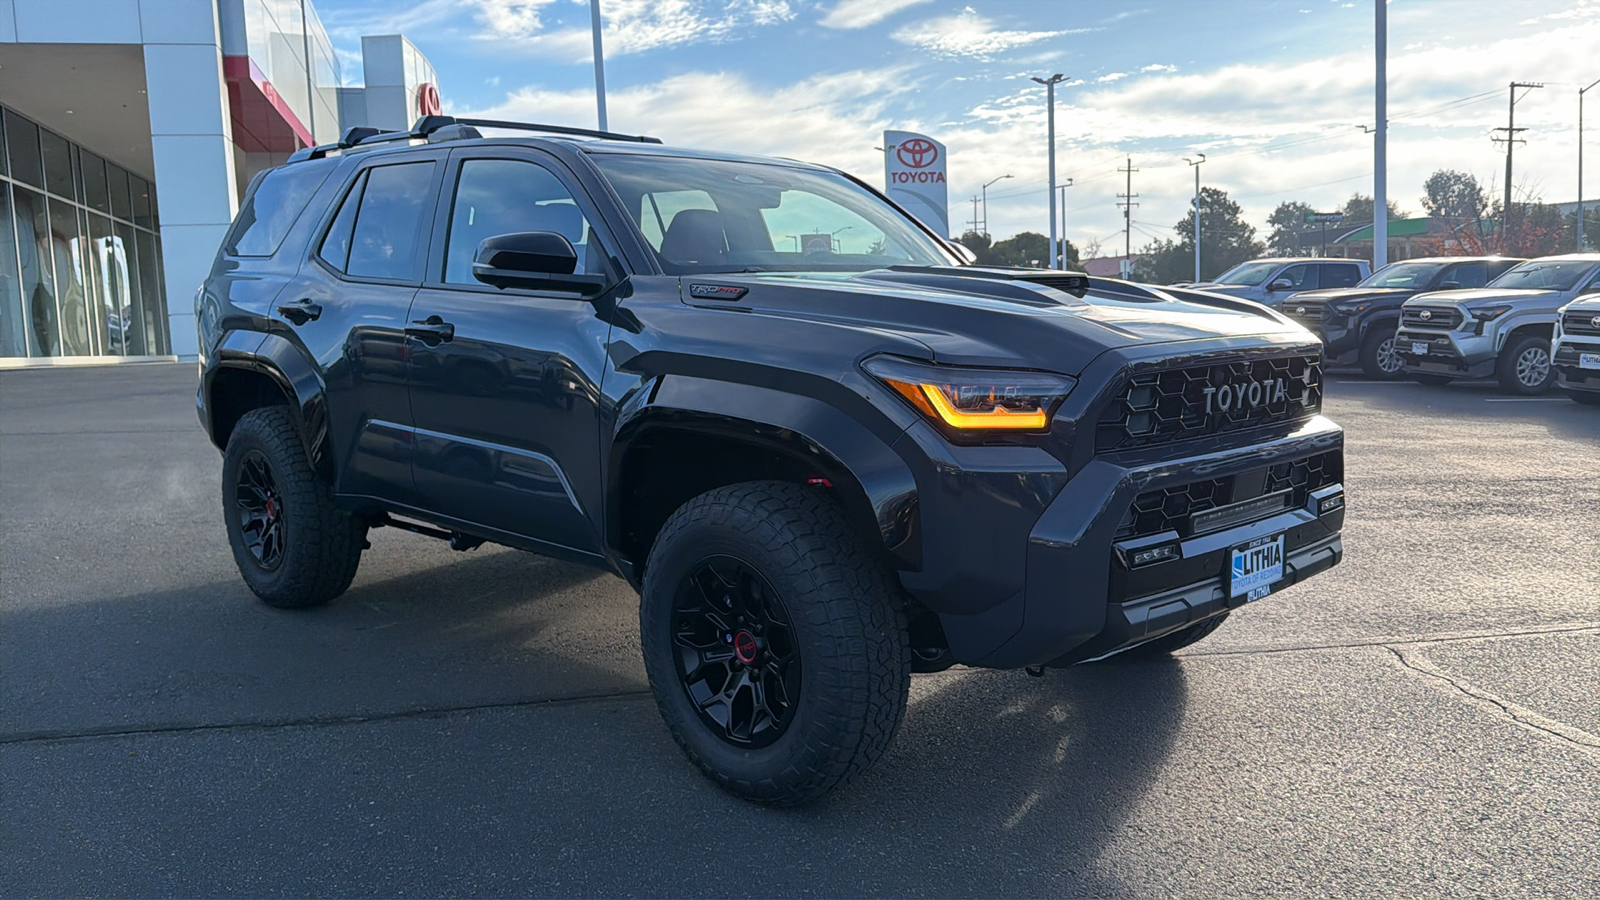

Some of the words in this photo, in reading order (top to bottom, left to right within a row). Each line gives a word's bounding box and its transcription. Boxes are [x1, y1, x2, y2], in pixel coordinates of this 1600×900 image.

[891, 171, 946, 184] TOYOTA
[1202, 378, 1285, 413] TOYOTA
[1243, 543, 1282, 576] LITHIA
[1232, 576, 1252, 590] TOYOTA
[1252, 572, 1260, 583] OF
[1260, 565, 1282, 580] REDDING
[1252, 584, 1271, 600] LITHIA
